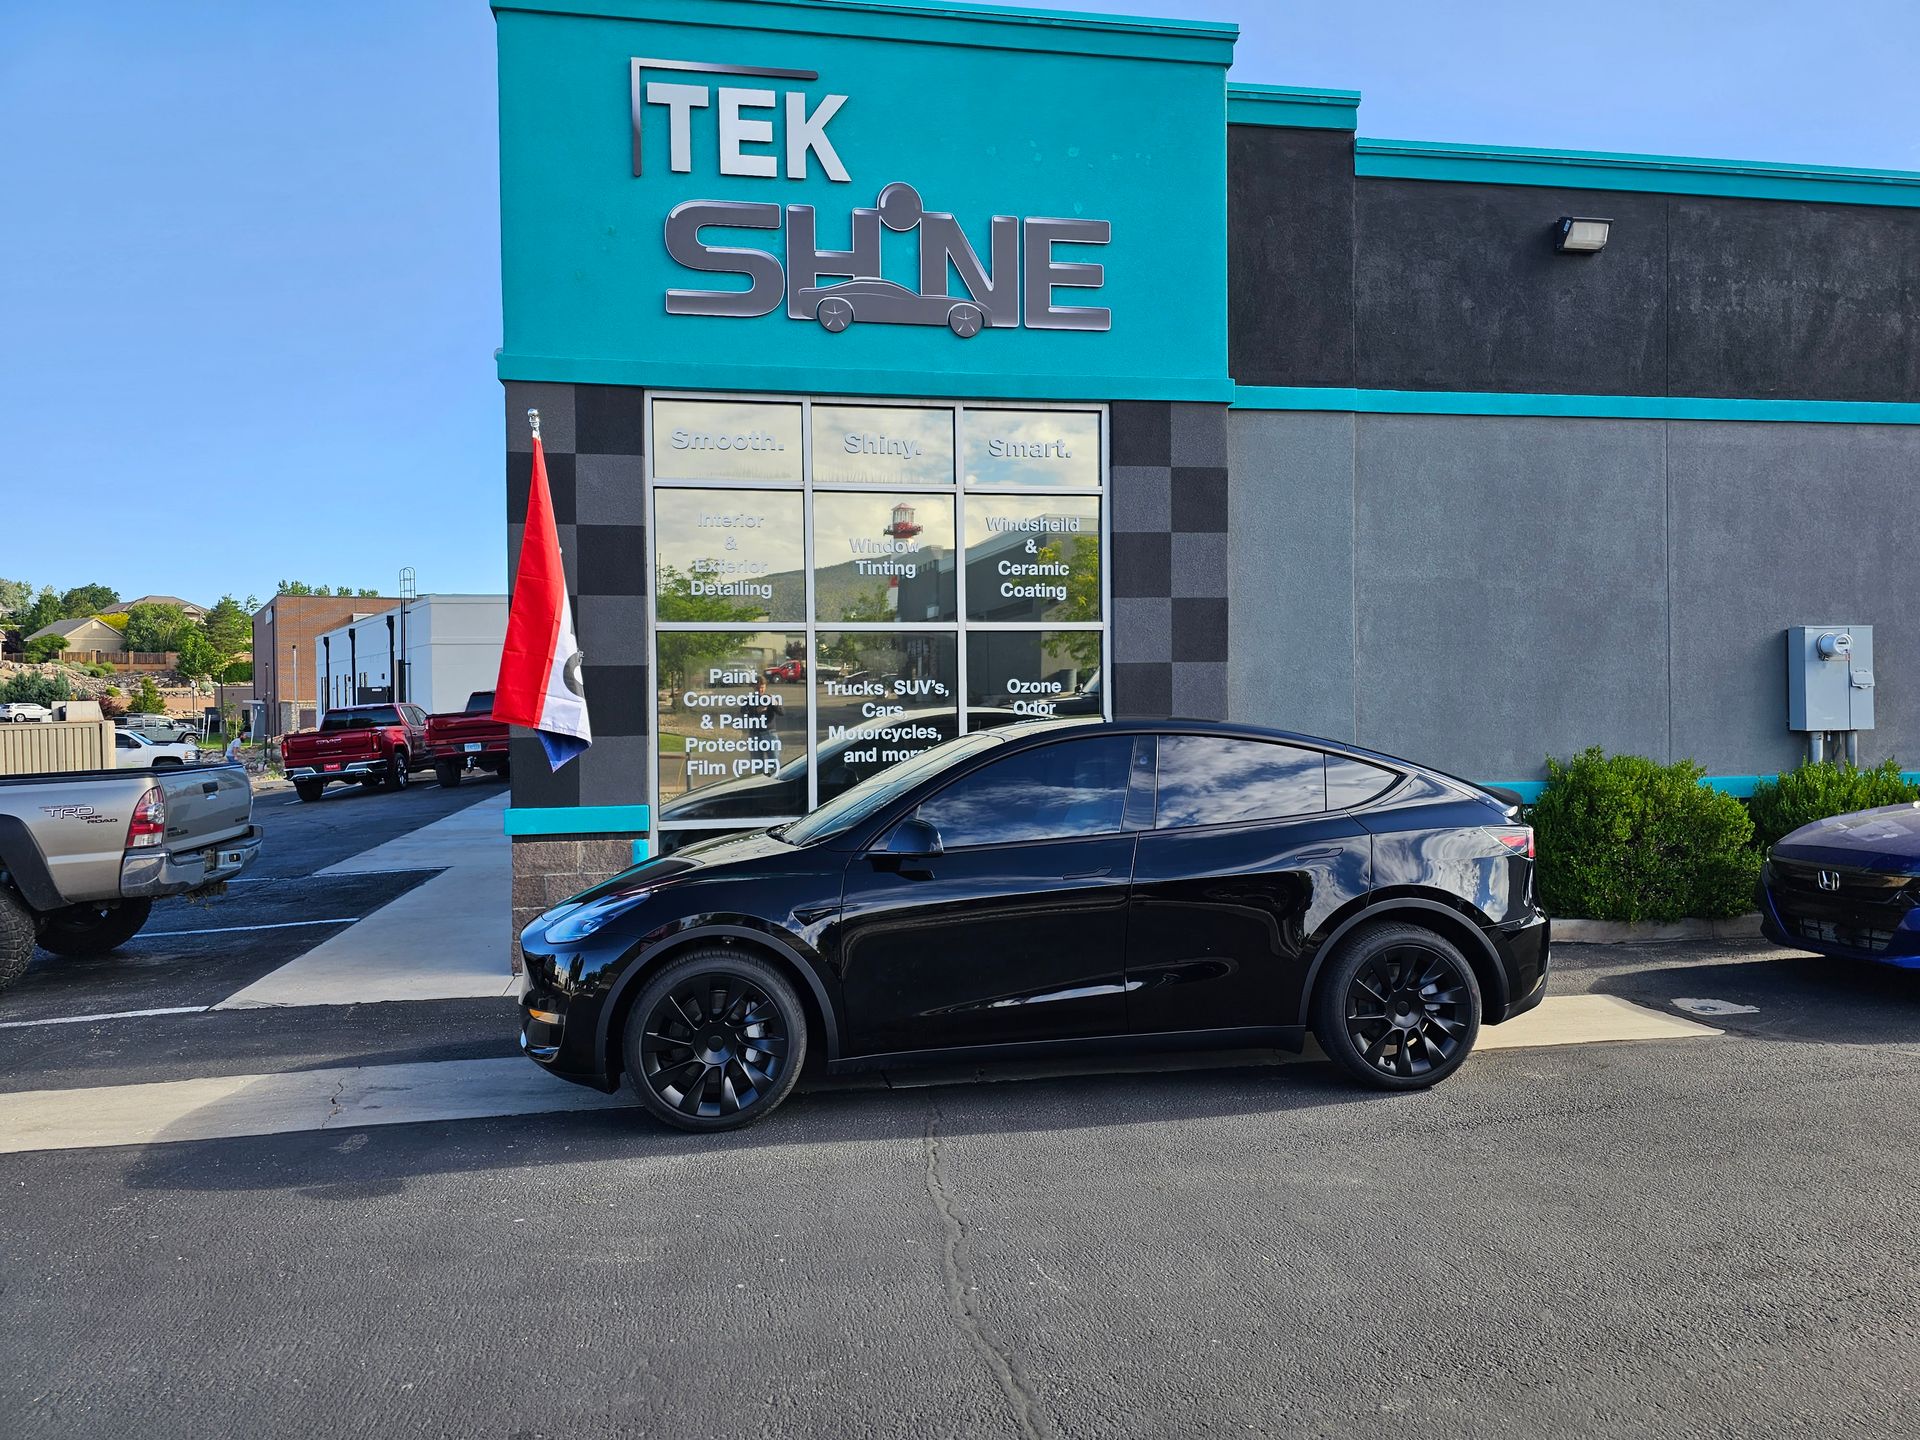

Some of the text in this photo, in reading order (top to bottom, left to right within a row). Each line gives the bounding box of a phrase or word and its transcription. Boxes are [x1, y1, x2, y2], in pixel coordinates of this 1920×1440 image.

[647, 82, 852, 182] TEK
[671, 427, 785, 451] Smooth.
[843, 432, 922, 459] Shiny.
[988, 439, 1073, 459] Smart.
[698, 512, 765, 528] Interior
[985, 516, 1080, 533] Windsheild
[724, 536, 738, 551] &
[849, 537, 919, 554] Window
[1024, 538, 1038, 554] &
[695, 558, 769, 574] Exterior
[856, 560, 916, 579] Tinting
[997, 560, 1070, 577] Ceramic
[691, 580, 773, 599] Detailing
[1000, 582, 1068, 601] Coating
[709, 668, 759, 685] Paint
[824, 679, 950, 698] Trucks, SUV's,
[1006, 678, 1062, 694] Ozone
[683, 691, 784, 708] Correction
[1013, 700, 1057, 715] Odor
[862, 702, 909, 720] Cars,
[700, 713, 768, 730] & Paint
[828, 724, 942, 743] Motorcycles,
[685, 736, 783, 753] Protection
[843, 746, 934, 763] and mor
[687, 758, 781, 778] Film (PPF)
[43, 805, 95, 820] TRD
